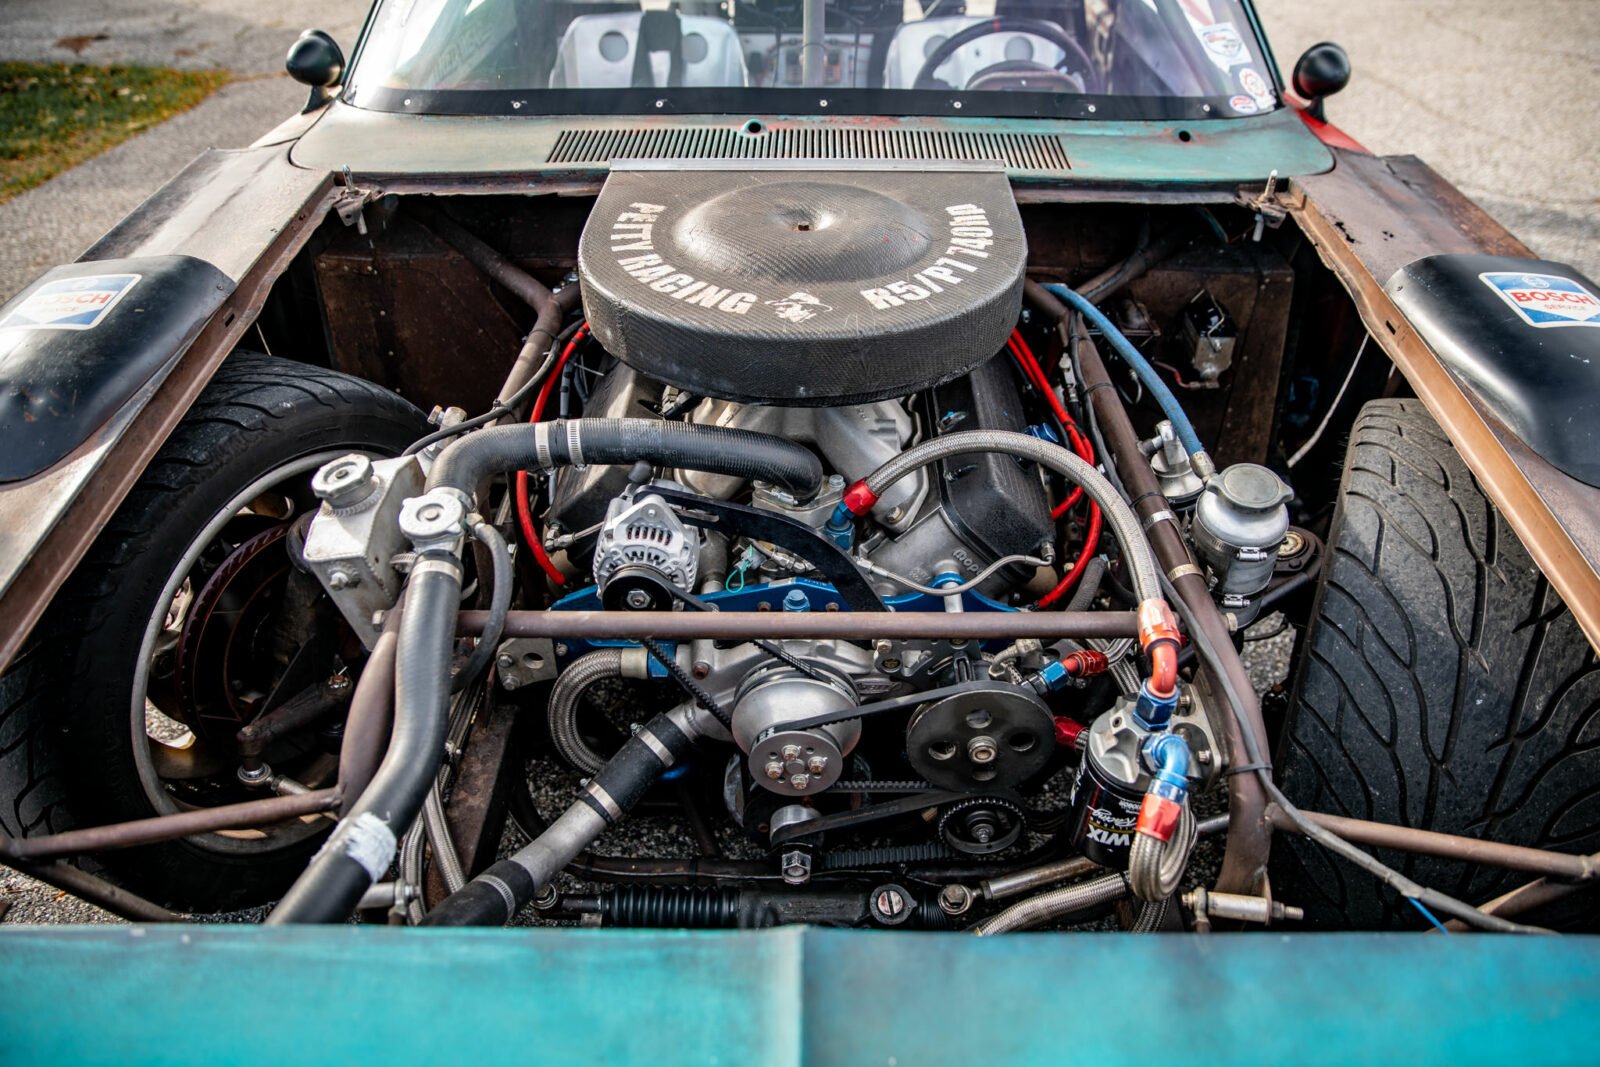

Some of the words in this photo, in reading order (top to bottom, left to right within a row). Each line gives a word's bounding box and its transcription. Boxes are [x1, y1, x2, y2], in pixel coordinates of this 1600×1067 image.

[610, 202, 668, 252] PETTY
[29, 293, 112, 305] OSCH
[617, 253, 758, 315] RACING
[860, 257, 979, 310] R5/P7
[1511, 291, 1597, 306] BOSCH
[1086, 823, 1130, 846] WIX
